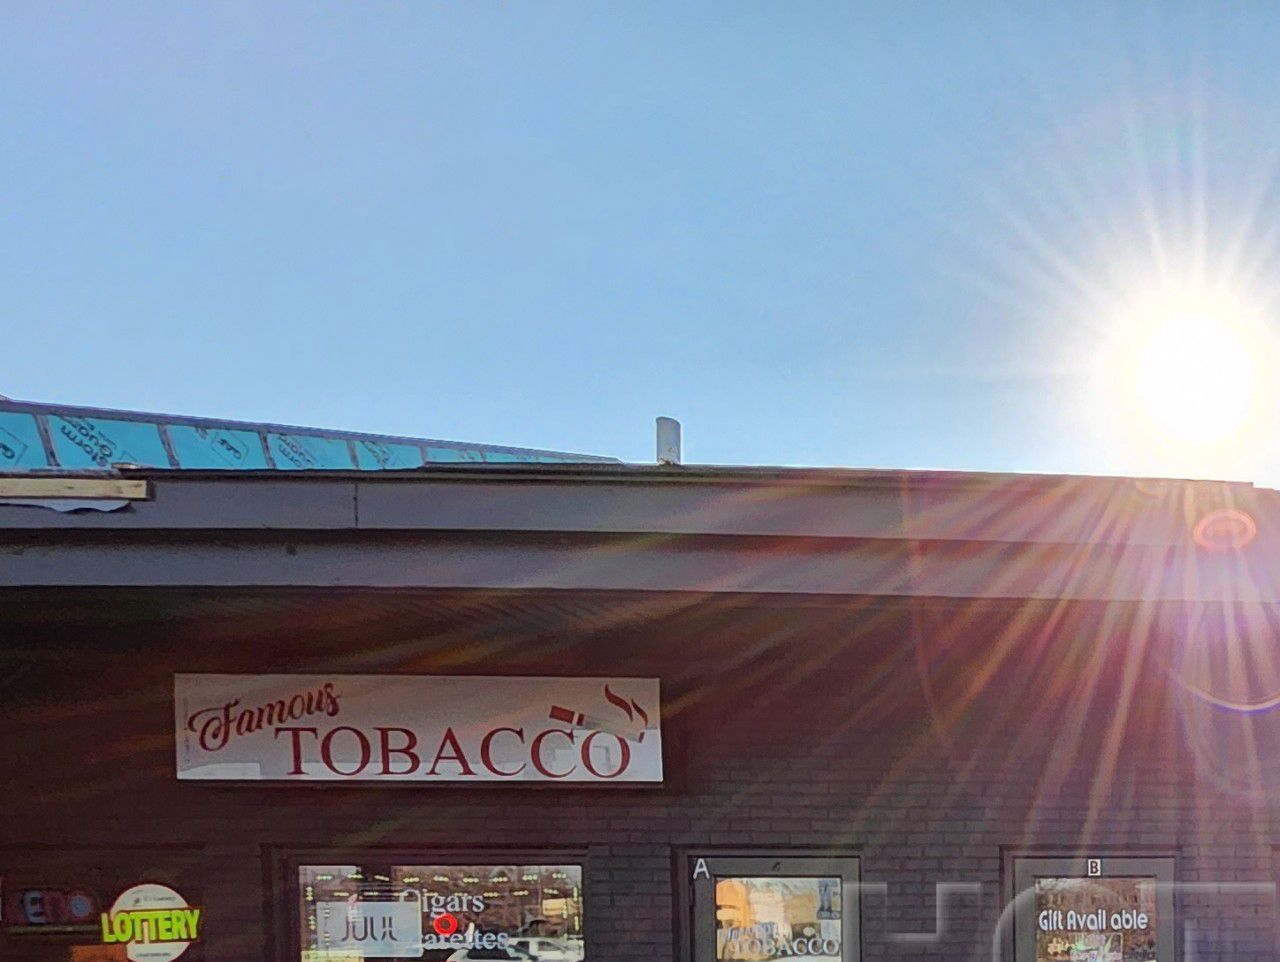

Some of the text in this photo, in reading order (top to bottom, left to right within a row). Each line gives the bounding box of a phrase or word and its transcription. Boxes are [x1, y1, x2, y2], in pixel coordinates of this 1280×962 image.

[187, 682, 342, 753] Famous
[274, 725, 631, 778] TOBACCO
[693, 859, 710, 880] A
[1089, 861, 1099, 874] B
[399, 887, 485, 918] igars
[101, 909, 200, 943] LOTTERY
[1039, 909, 1063, 931] Gift
